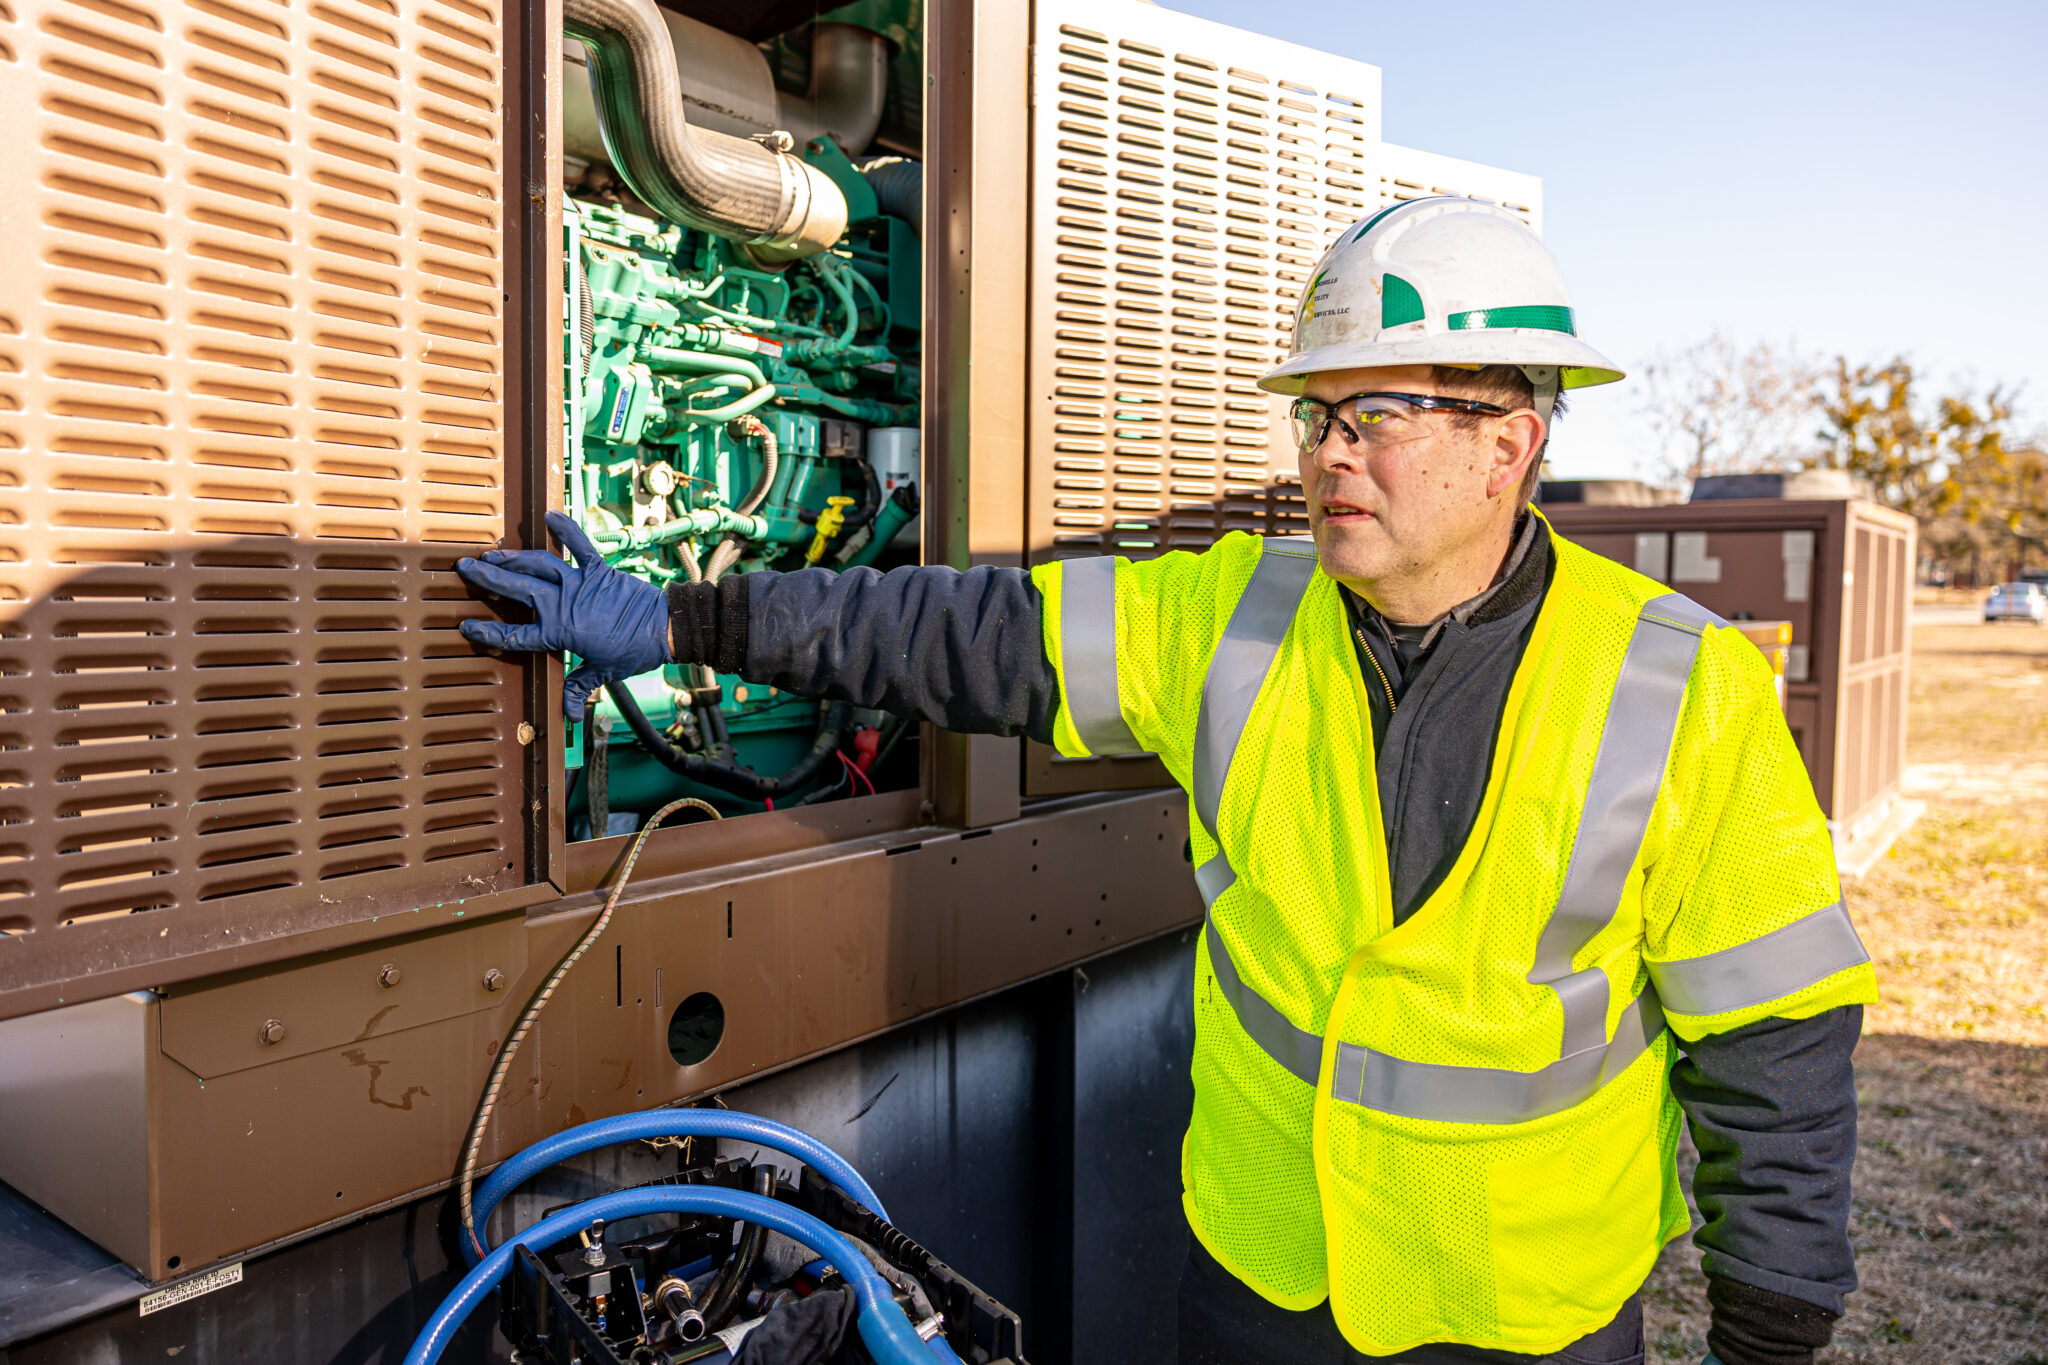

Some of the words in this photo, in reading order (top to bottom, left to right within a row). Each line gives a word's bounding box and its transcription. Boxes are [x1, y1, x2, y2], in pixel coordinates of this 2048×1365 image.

[1337, 307, 1350, 315] LLC
[165, 1280, 191, 1294] DMLSS
[192, 1273, 209, 1285] RPIE
[210, 1270, 219, 1278] ID
